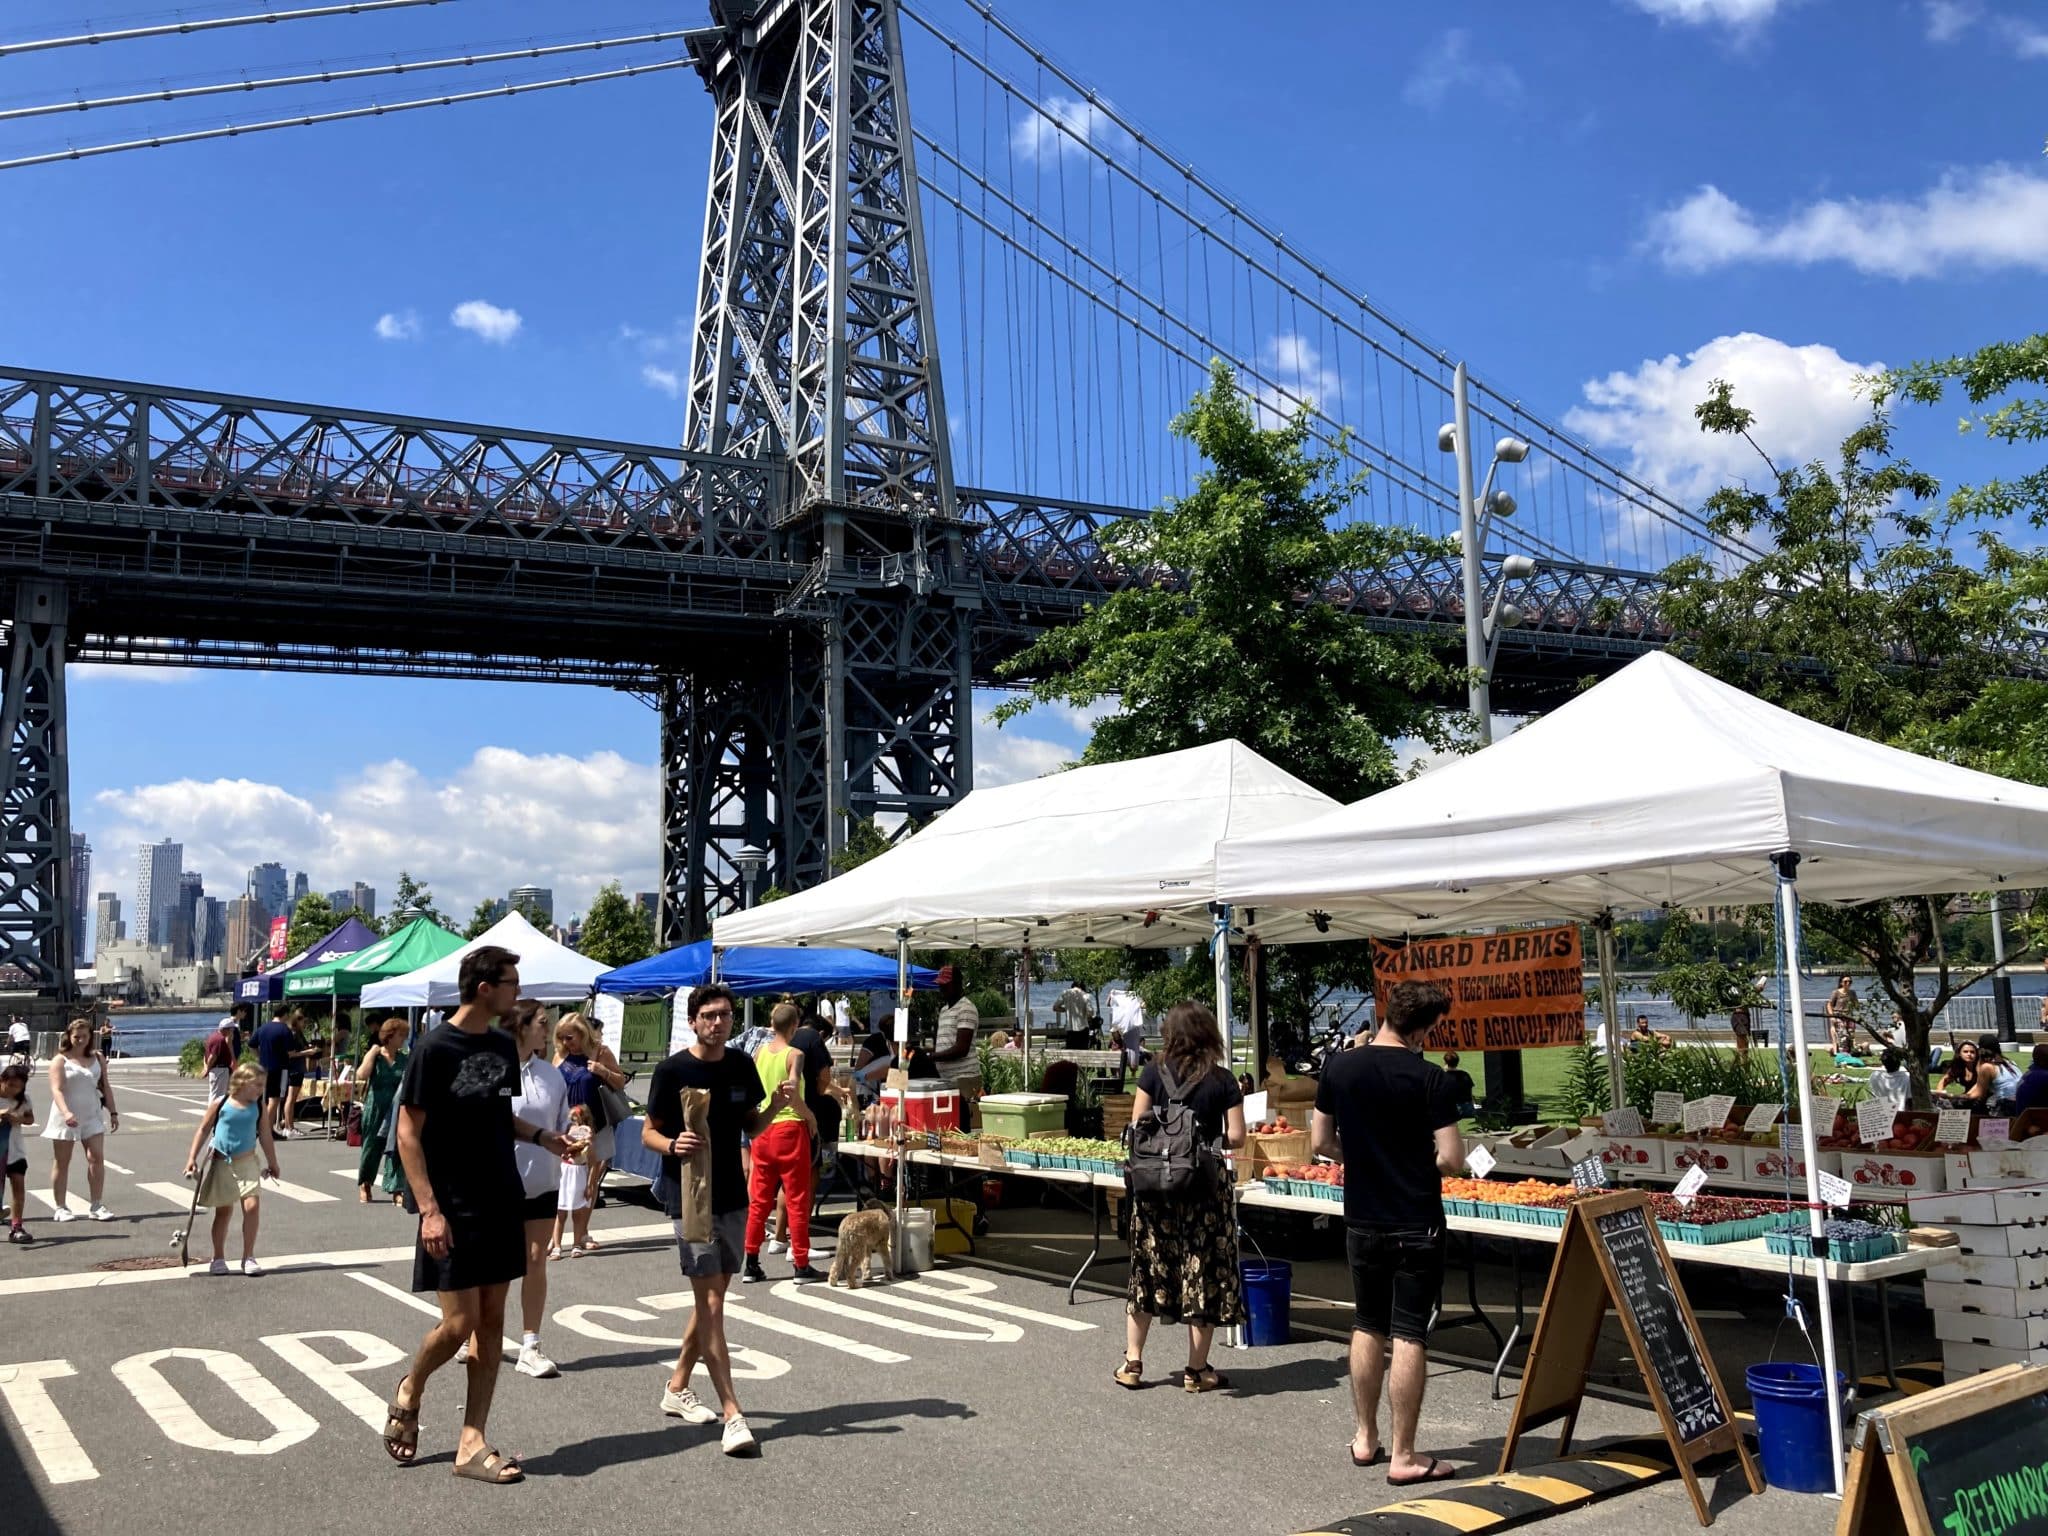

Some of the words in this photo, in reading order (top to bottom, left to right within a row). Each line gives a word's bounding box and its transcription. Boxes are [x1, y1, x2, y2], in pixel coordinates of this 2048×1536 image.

[1371, 942, 1473, 974] MAYNARD
[1482, 930, 1573, 965] FARMS
[1457, 973, 1520, 1002] VEGETABLES
[1523, 976, 1533, 998] &
[1534, 967, 1583, 996] BERRIES
[1461, 1018, 1478, 1048] OF
[1484, 1011, 1584, 1046] AGRICULTURE
